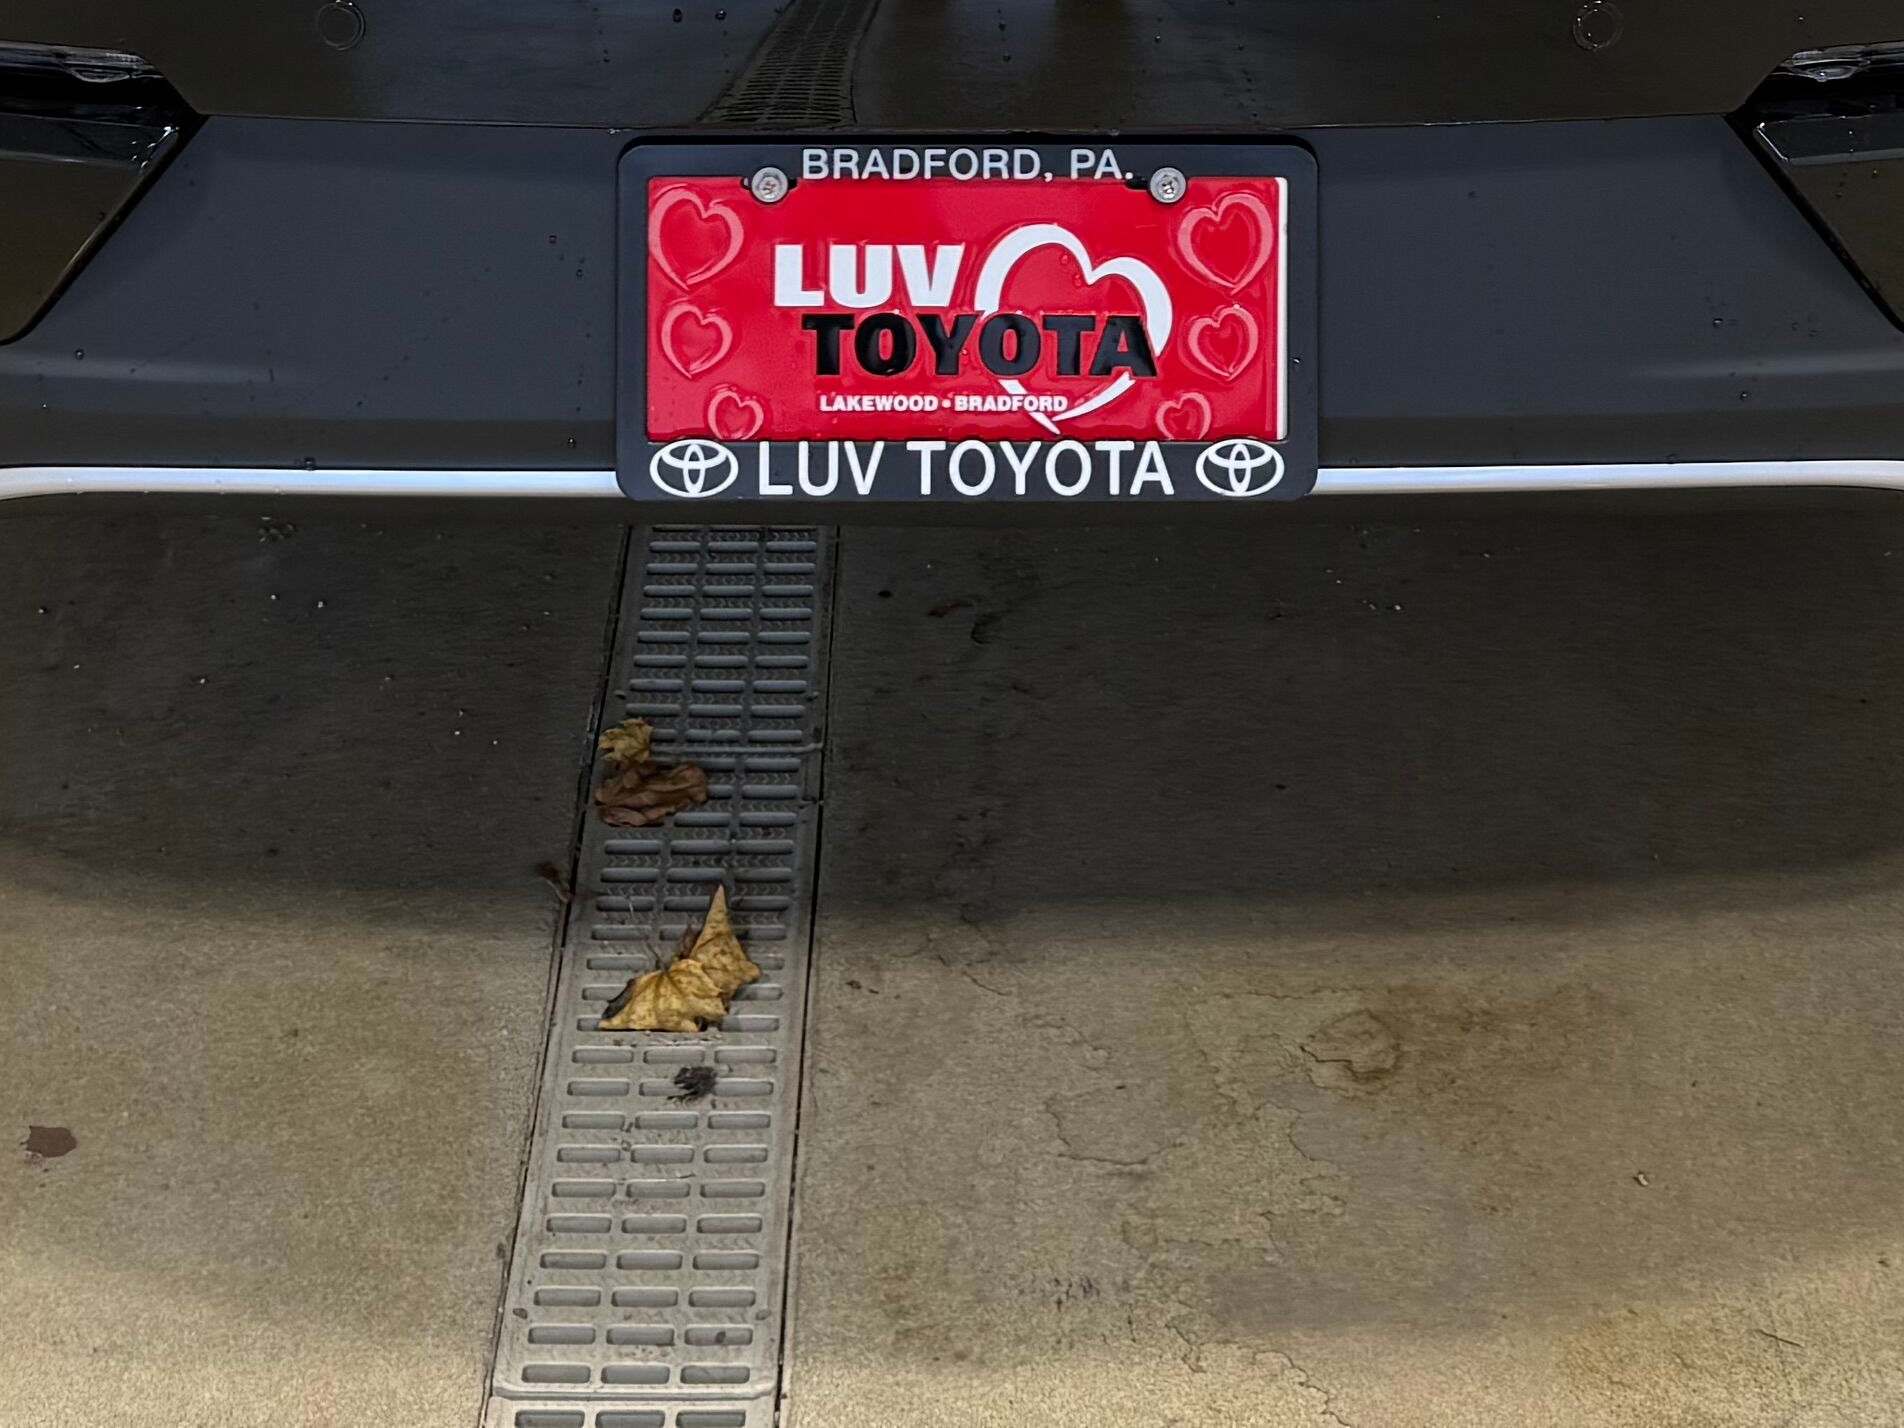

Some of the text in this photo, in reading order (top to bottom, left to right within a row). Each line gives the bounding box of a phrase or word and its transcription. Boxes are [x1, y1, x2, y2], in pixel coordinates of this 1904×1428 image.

[801, 148, 1134, 182] BRADFORD, PA.
[773, 243, 964, 307] LUV
[802, 313, 1159, 378] TOYOTA
[819, 394, 1068, 412] LAKEWOOD BRADFORD
[759, 440, 1176, 497] LUV TOYOTA
